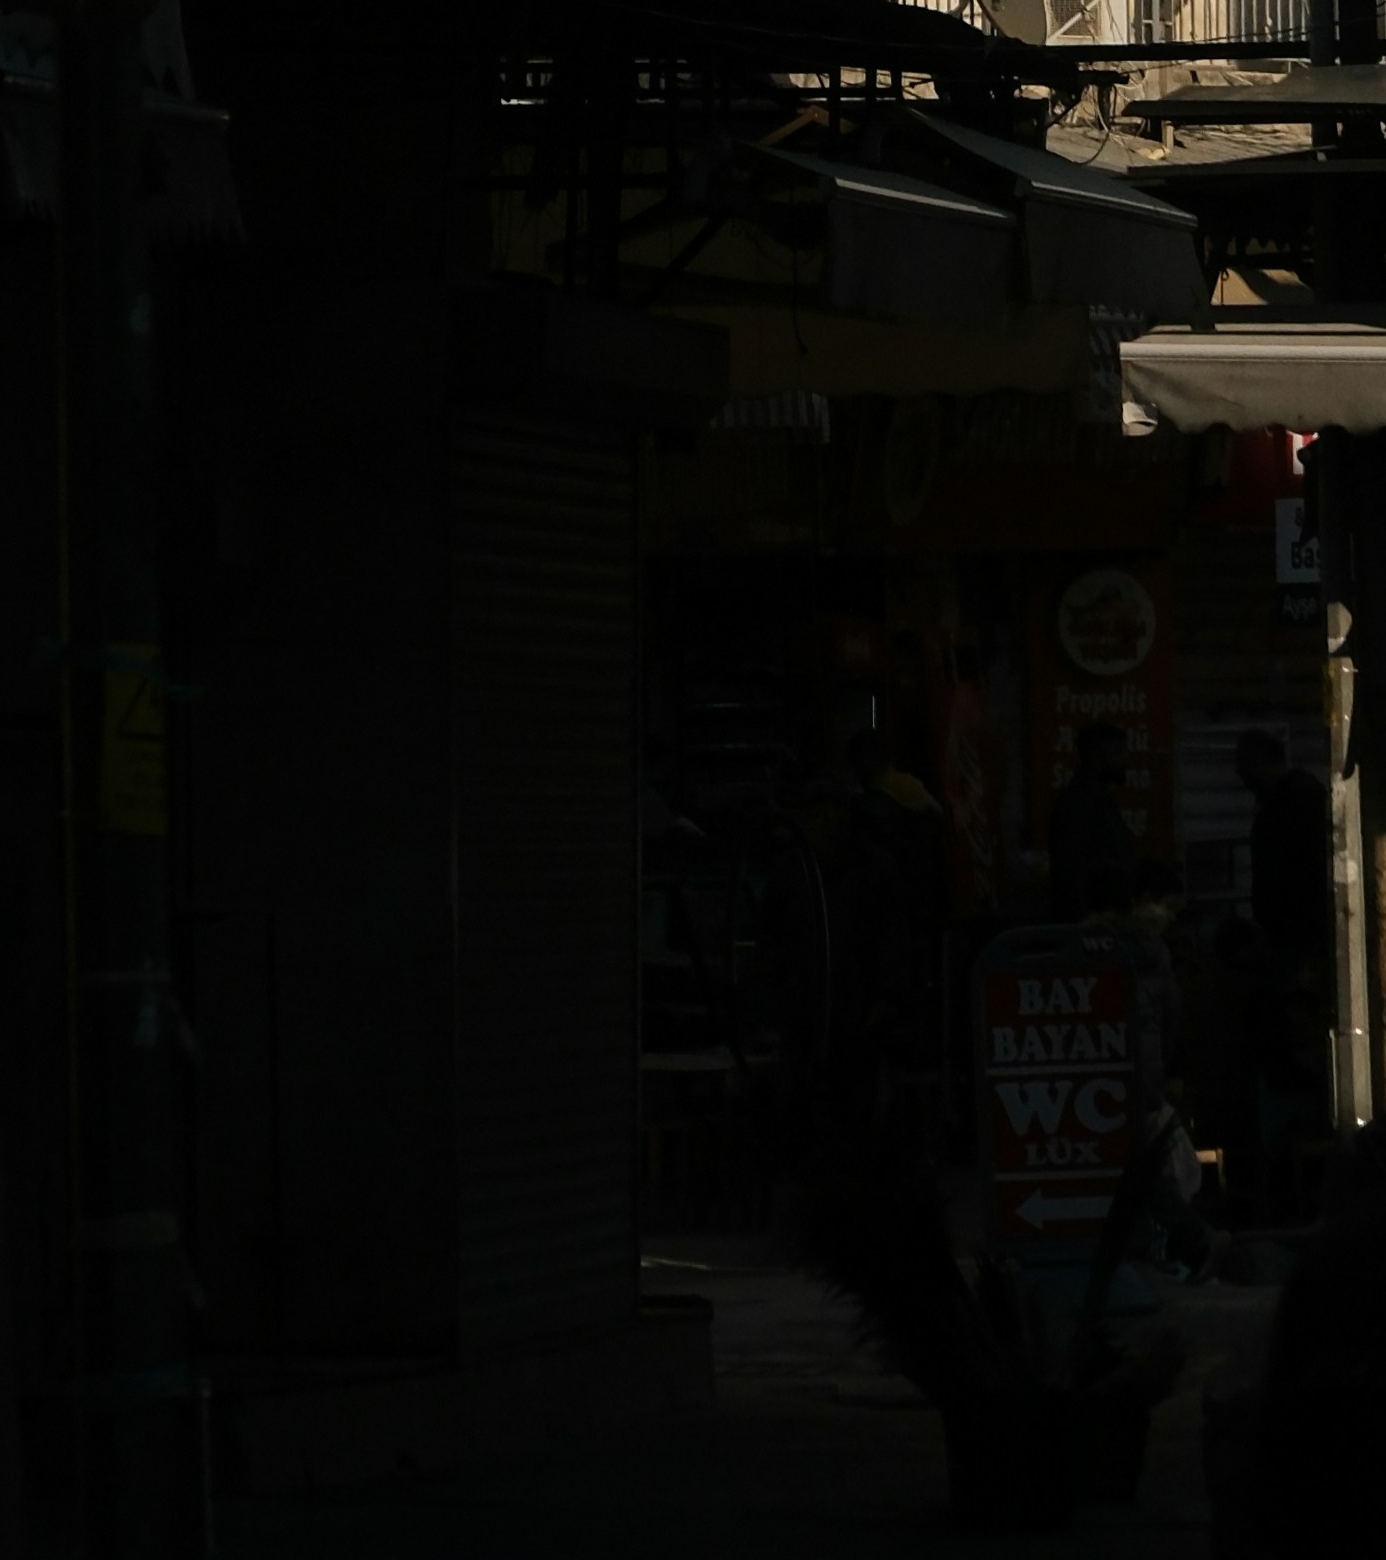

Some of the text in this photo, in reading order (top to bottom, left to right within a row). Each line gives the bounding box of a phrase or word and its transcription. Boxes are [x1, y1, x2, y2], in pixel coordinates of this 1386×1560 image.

[1055, 683, 1147, 720] Propolis
[1082, 936, 1115, 952] WC
[1017, 976, 1098, 1016] BAY
[991, 1022, 1128, 1063] BAYAN
[994, 1077, 1128, 1137] WC
[1024, 1136, 1102, 1167] LÜX
